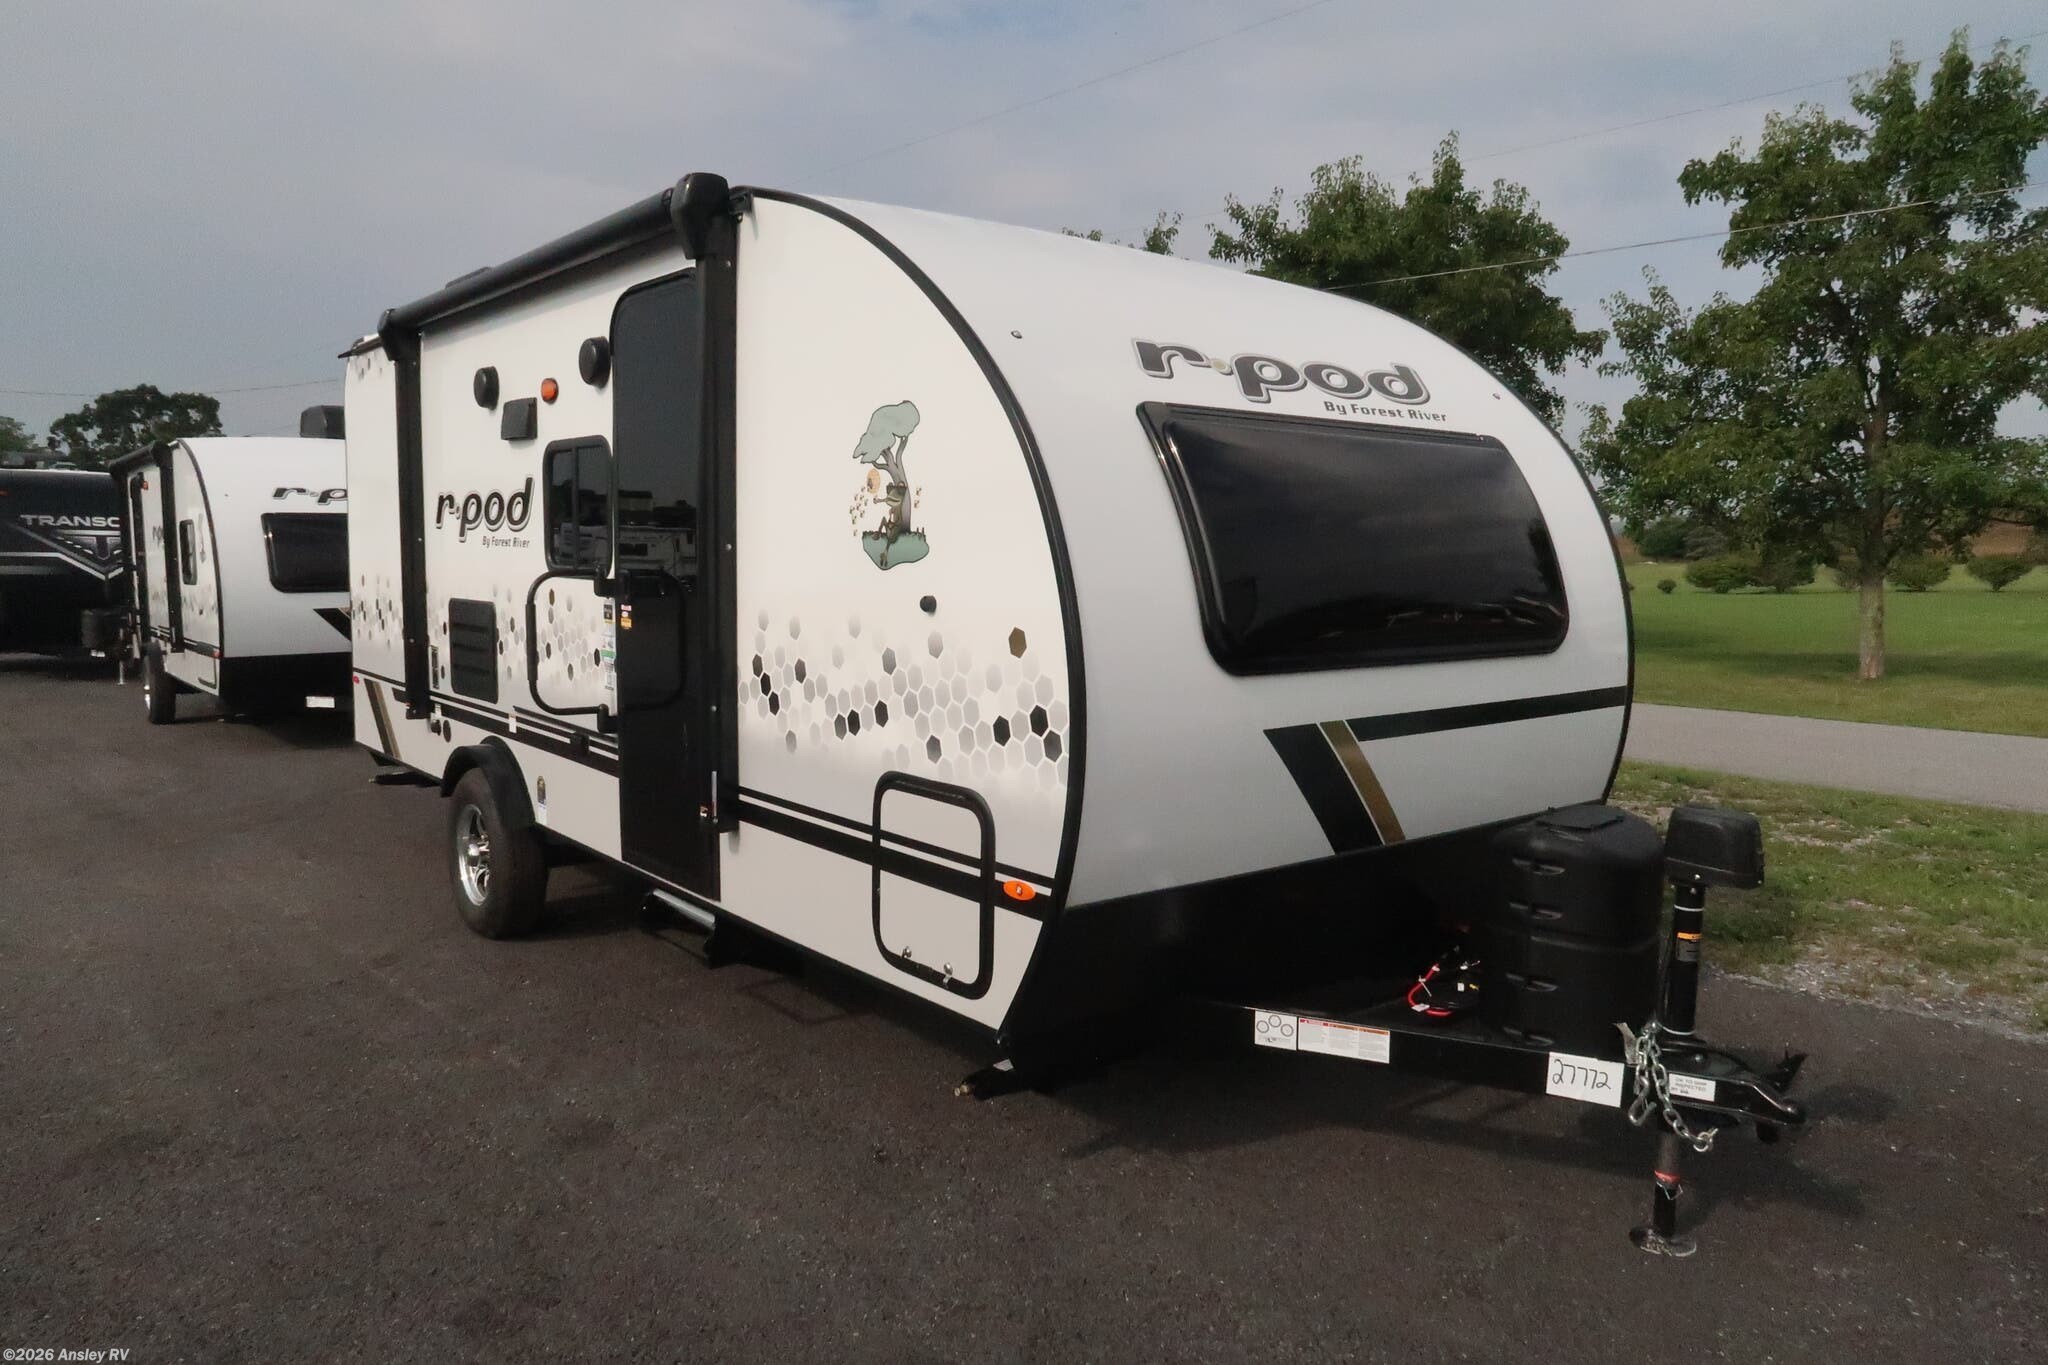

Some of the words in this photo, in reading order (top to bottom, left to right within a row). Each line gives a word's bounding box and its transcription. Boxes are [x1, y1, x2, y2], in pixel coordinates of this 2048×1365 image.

[1324, 400, 1347, 415] By
[1350, 404, 1405, 418] Forest
[1408, 406, 1448, 422] River
[492, 536, 511, 548] Forest
[1552, 1059, 1611, 1090] 27772
